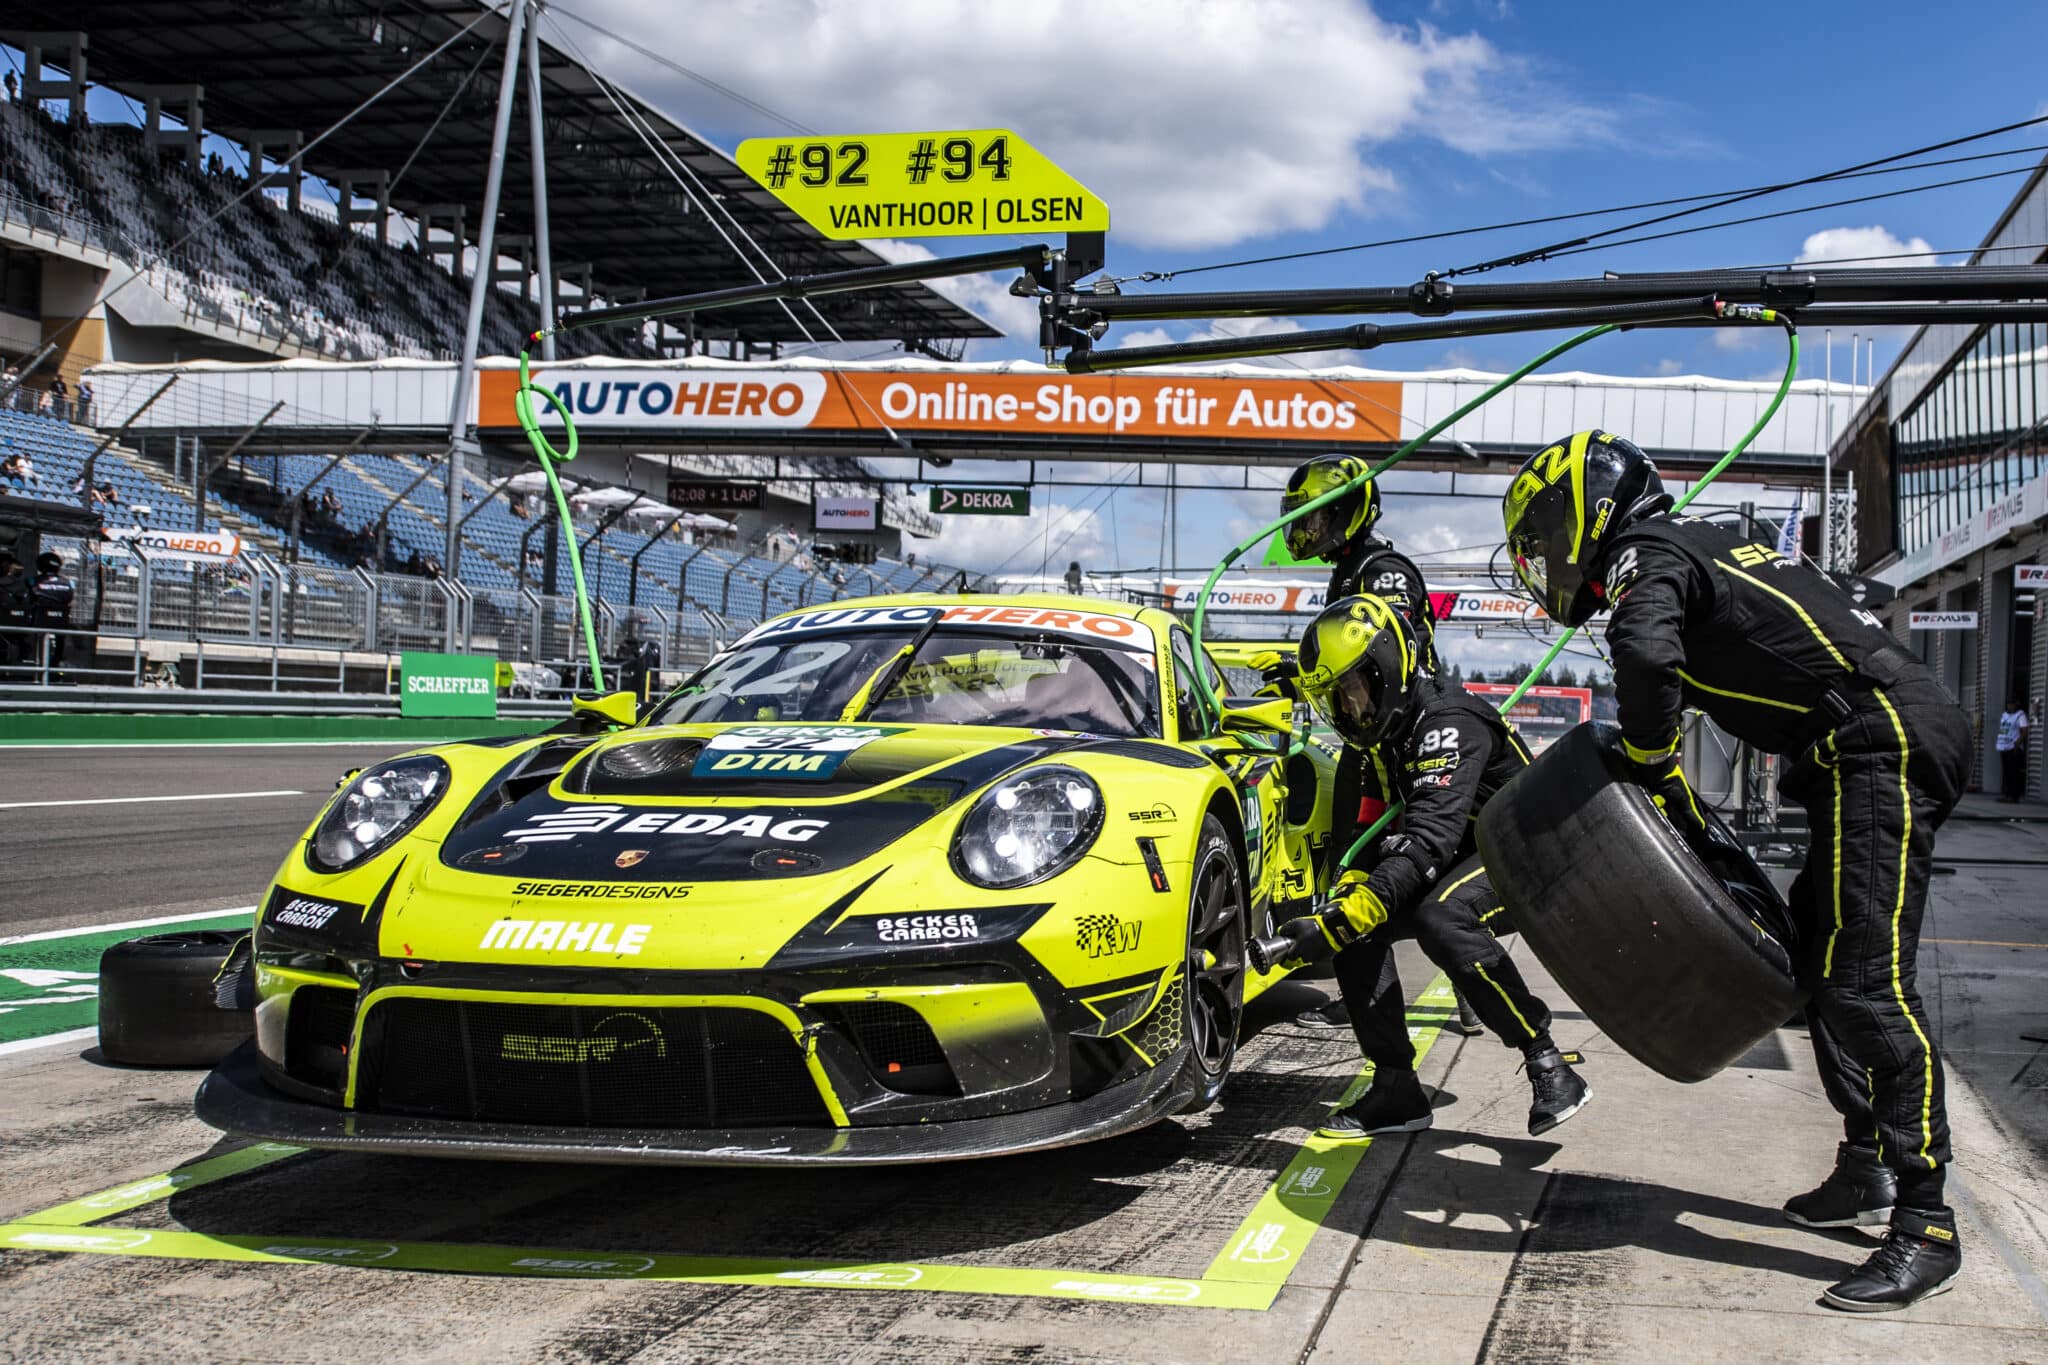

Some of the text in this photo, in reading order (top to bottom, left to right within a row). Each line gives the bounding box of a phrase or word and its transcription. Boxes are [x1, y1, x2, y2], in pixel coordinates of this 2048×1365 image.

[765, 135, 1012, 189] #92 #94
[829, 201, 974, 229] VANTHOOR
[996, 197, 1083, 223] OLSEN
[542, 381, 804, 417] AUTOHERO
[881, 381, 1356, 432] Online-Shop für Autos
[1513, 444, 1572, 503] 92
[732, 488, 757, 502] LAP
[962, 492, 1014, 509] DEKRA
[822, 508, 870, 518] AUTOHERO
[120, 534, 222, 556] TOHERO
[1184, 591, 1277, 604] ATOHERO
[1459, 598, 1529, 613] TOHERO
[766, 606, 1135, 637] AUTOHERO
[1919, 615, 1972, 623] REMUS
[408, 676, 489, 694] SCHAEFFLER
[744, 737, 833, 750] 92
[710, 753, 826, 771] DTM
[1128, 810, 1162, 821] SSR
[615, 812, 830, 842] EDAG
[511, 882, 694, 899] SIEGERDESIGNS
[285, 899, 339, 918] BECKER
[275, 910, 328, 930] CARBON
[876, 914, 976, 930] BECKER
[479, 919, 653, 955] MAHLE
[878, 925, 979, 941] CARBON
[1088, 920, 1142, 958] KW
[501, 1033, 618, 1063] SSR
